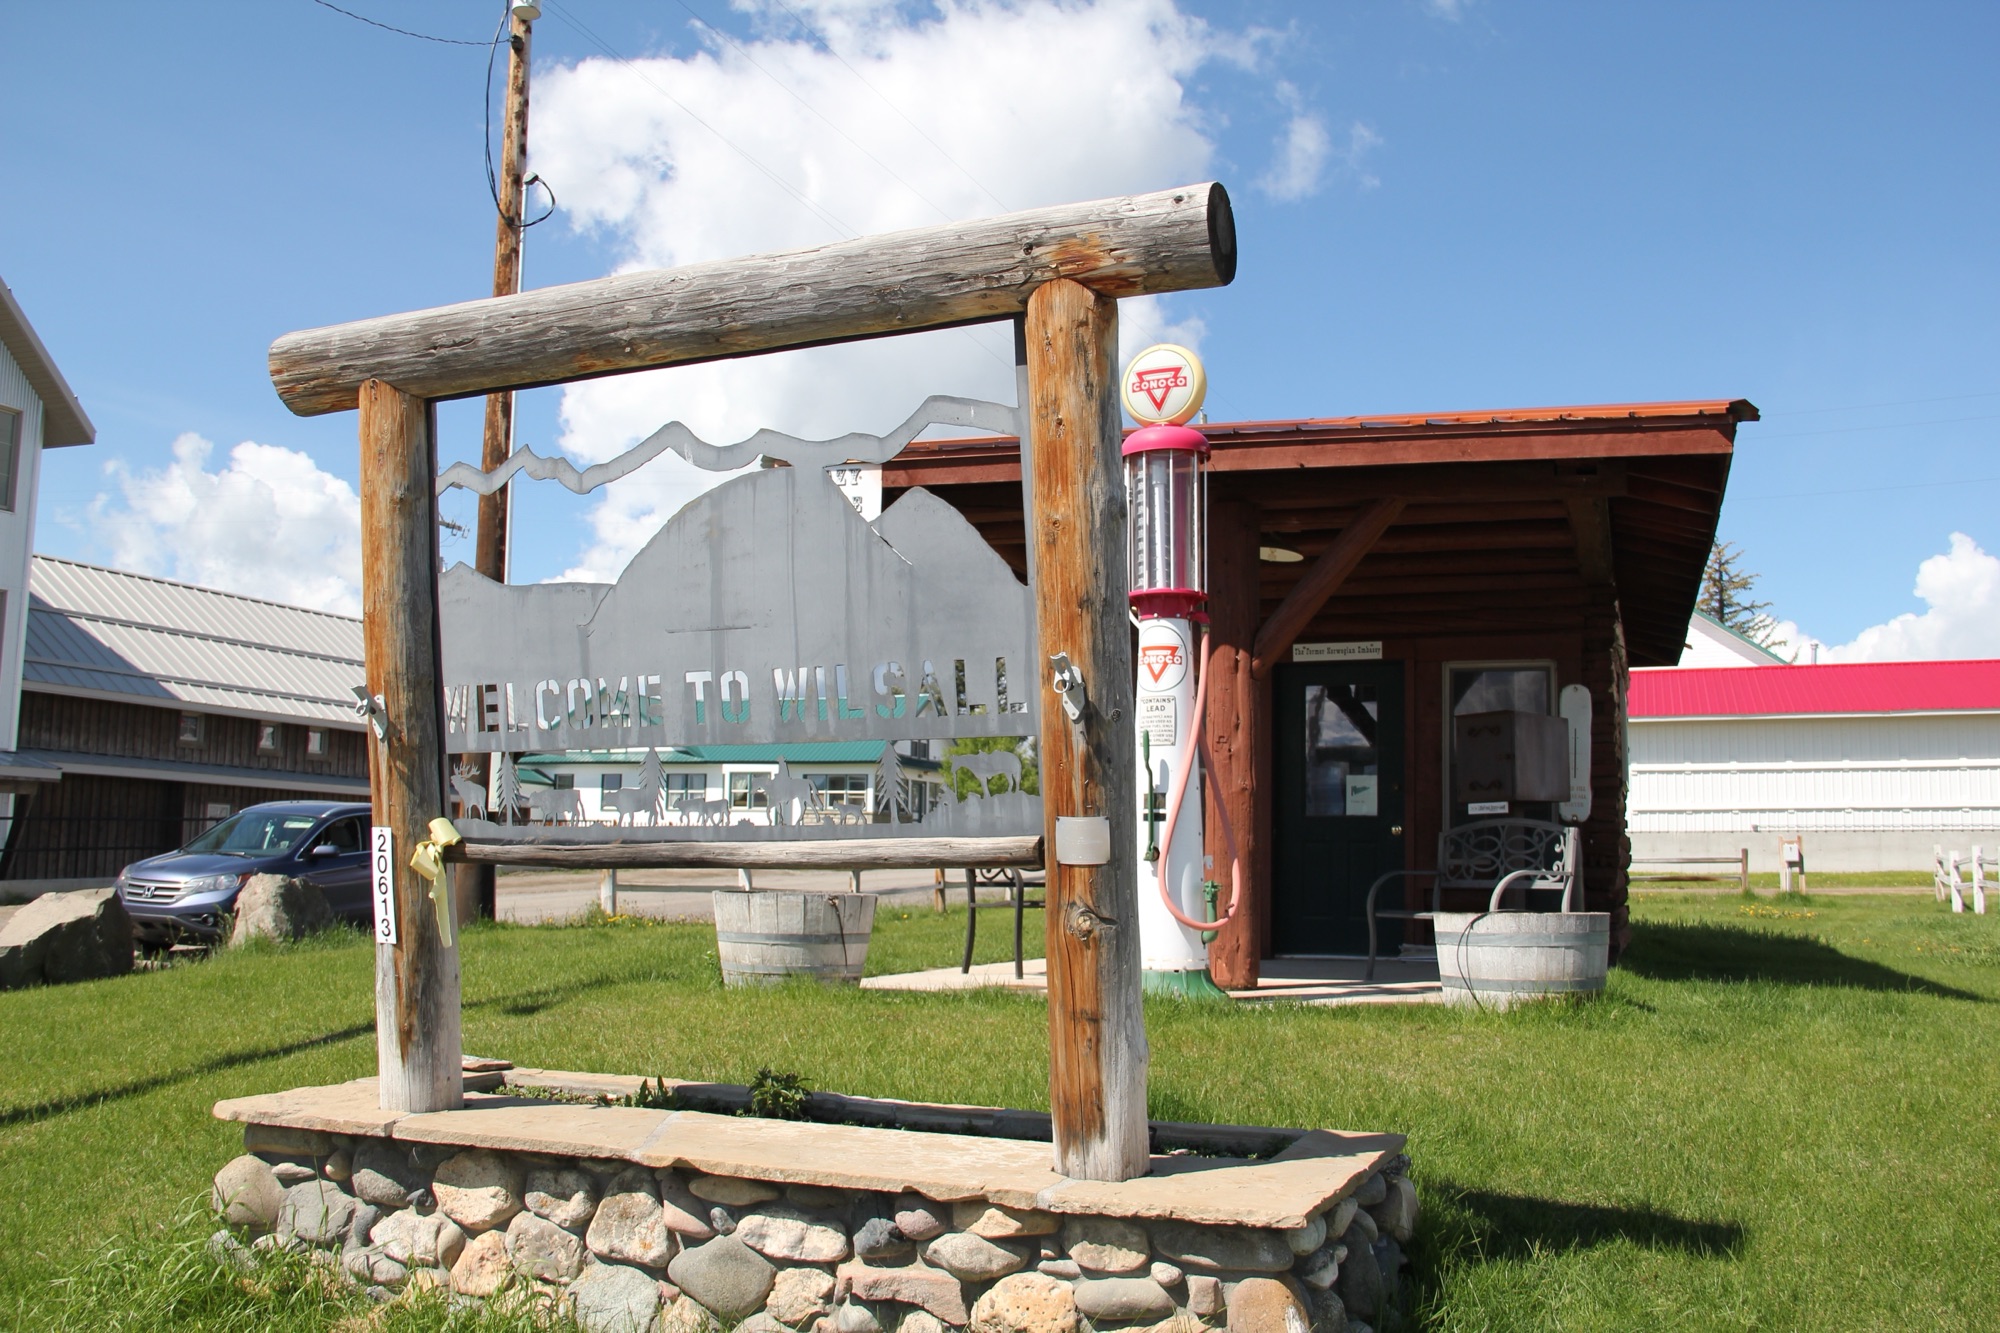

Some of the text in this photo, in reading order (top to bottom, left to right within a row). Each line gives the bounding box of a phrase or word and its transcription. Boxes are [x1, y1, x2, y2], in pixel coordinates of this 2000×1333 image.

[1132, 377, 1186, 392] CONOCO
[1326, 646, 1355, 656] Norwegian
[1357, 645, 1381, 655] Embassy
[1139, 655, 1182, 665] CONOCO
[443, 656, 1028, 734] WELCOME TO WILSALL
[1146, 704, 1166, 712] LEAD
[377, 833, 392, 938] 20613
